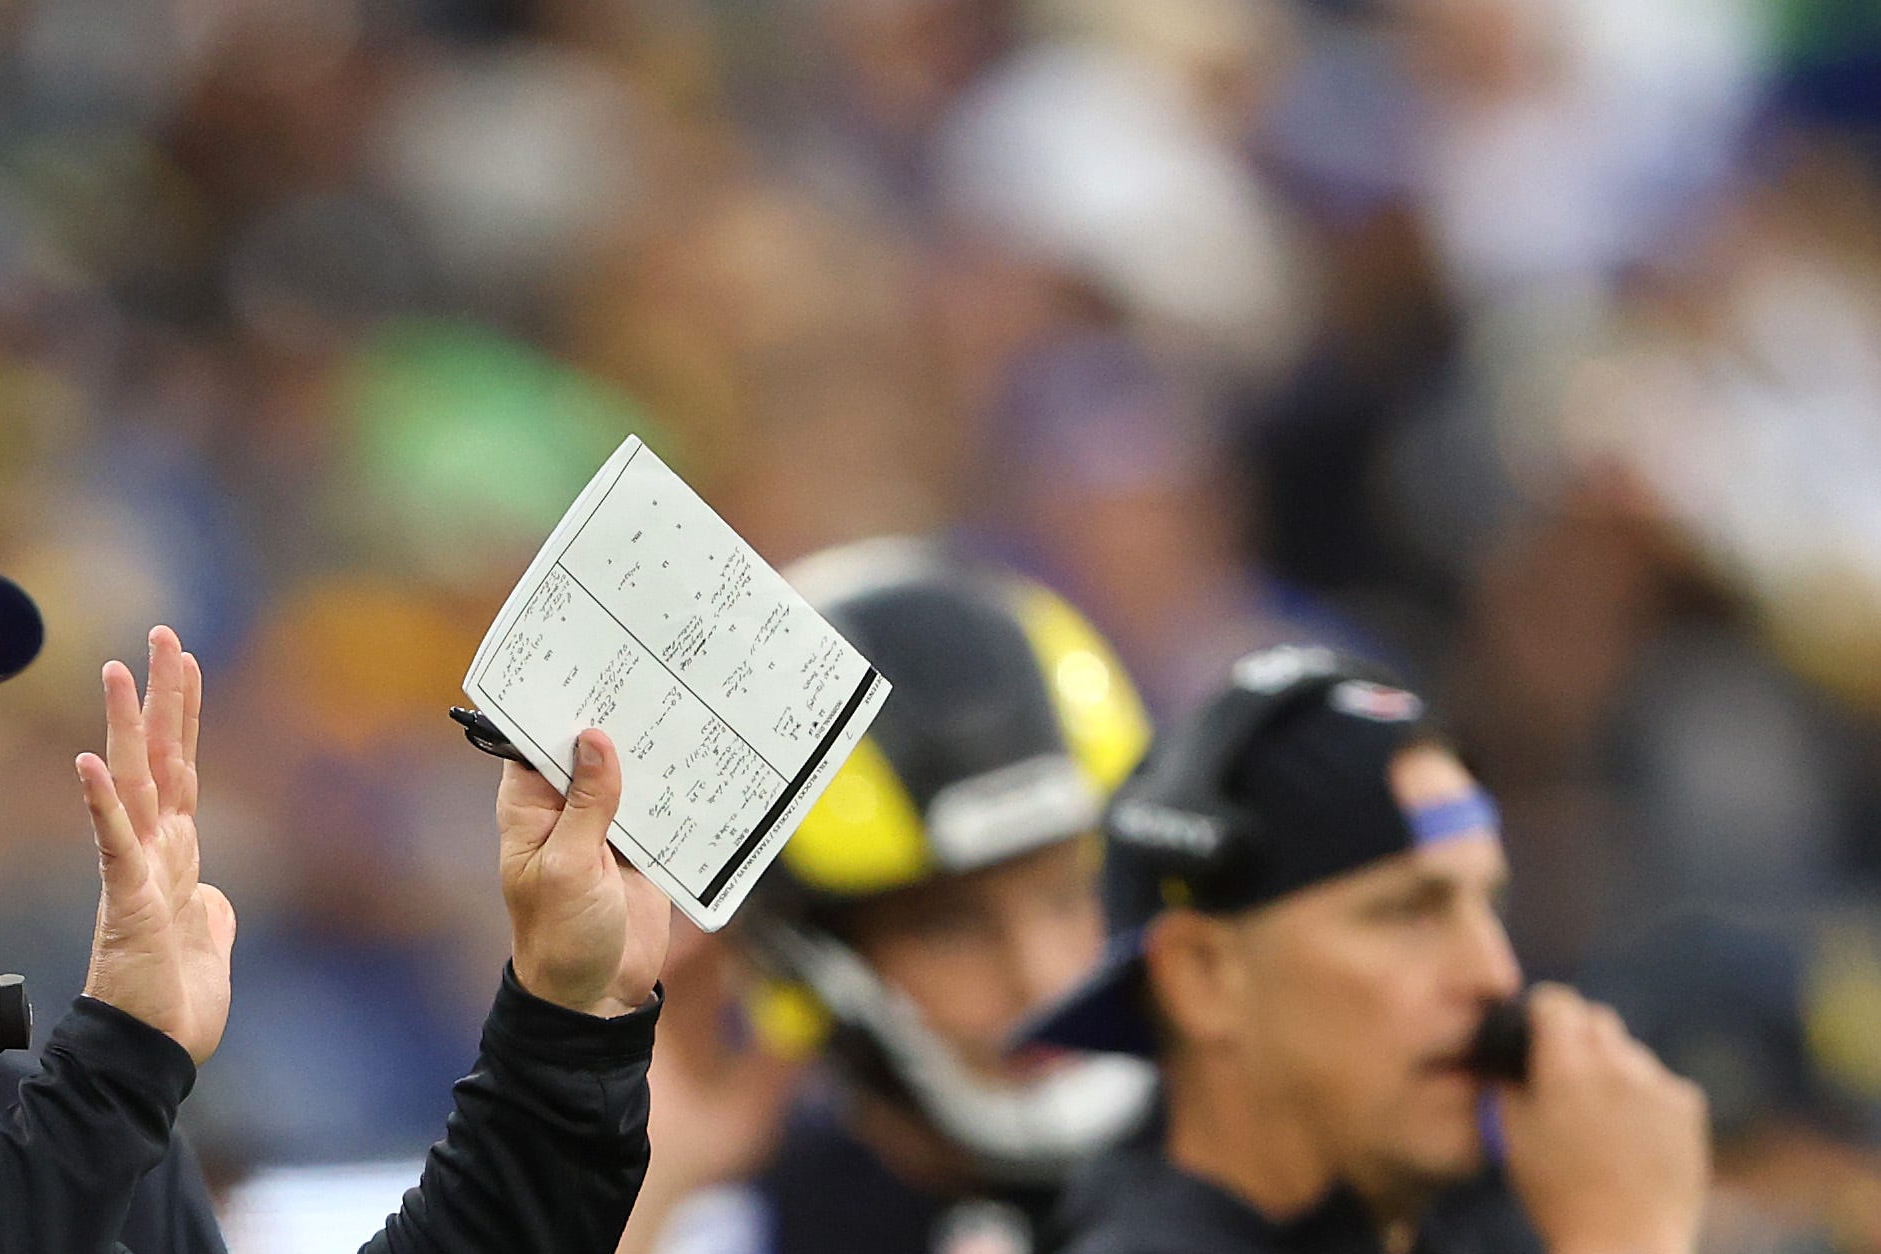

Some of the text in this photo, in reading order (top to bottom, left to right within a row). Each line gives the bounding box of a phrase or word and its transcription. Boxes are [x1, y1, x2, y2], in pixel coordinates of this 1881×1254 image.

[797, 773, 818, 800] BLOCKS
[772, 804, 795, 833] TACKLES
[736, 837, 770, 878] TAKEAWAYS
[711, 882, 734, 912] PURSUIT
